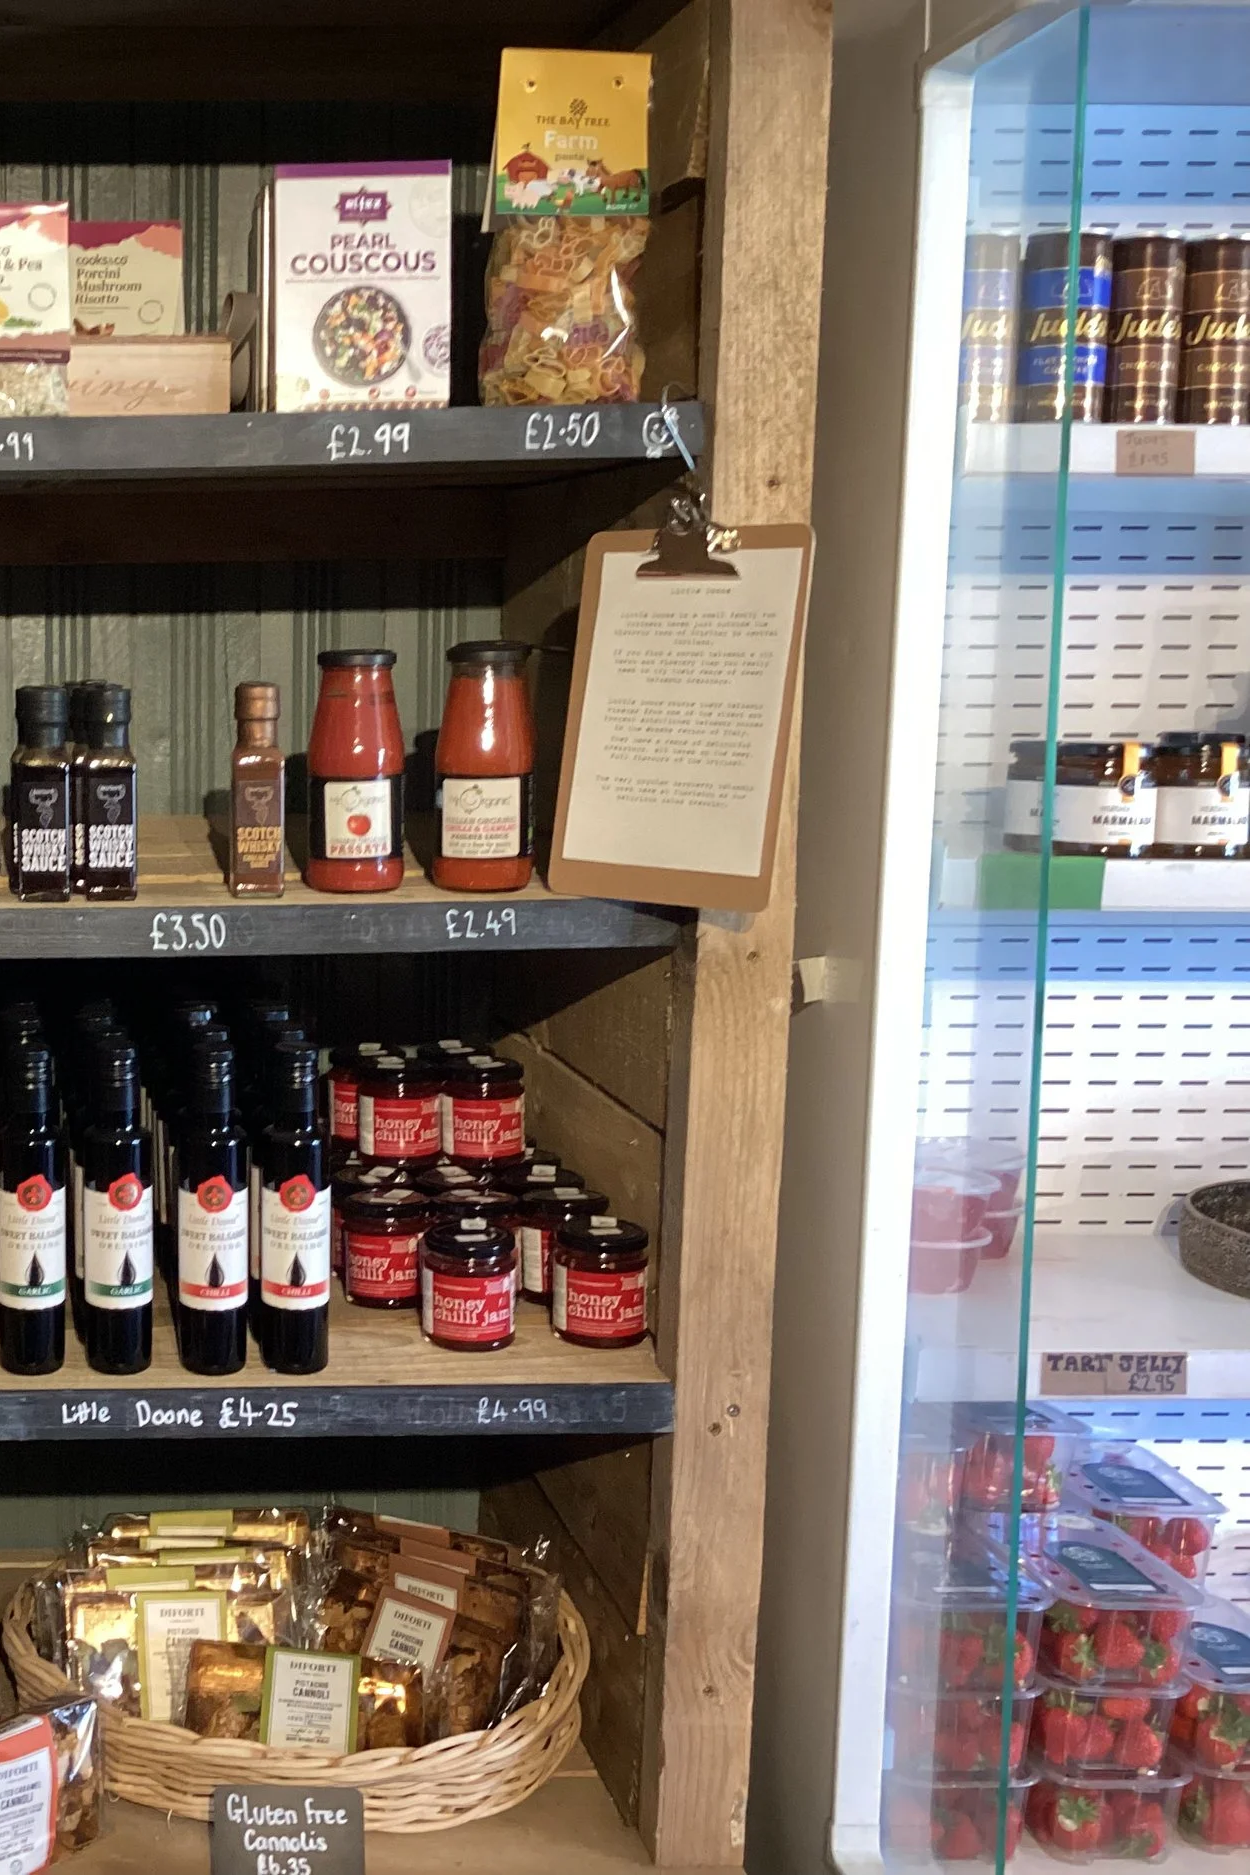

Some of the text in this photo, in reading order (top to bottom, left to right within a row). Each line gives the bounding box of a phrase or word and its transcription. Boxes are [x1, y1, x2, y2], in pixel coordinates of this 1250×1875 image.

[536, 115, 611, 128] THE BAY TREE
[544, 130, 598, 150] Farm
[330, 233, 396, 250] PEARL
[18, 258, 43, 271] Pea
[290, 251, 437, 277] COUSCOUS
[76, 268, 121, 280] Porcini
[76, 280, 142, 292] Mushroom
[75, 292, 120, 304] Risotto
[525, 411, 601, 451] £2.50
[327, 422, 411, 460] £2.99
[21, 828, 66, 843] SCOTCH
[88, 824, 133, 840] SCOTCH
[237, 826, 282, 840] SCOTCH
[21, 842, 66, 856] WHISKY
[88, 838, 133, 853] WHISKY
[237, 839, 282, 853] WHISKY
[21, 854, 66, 872] SAUCE
[88, 851, 134, 868] SAUCE
[149, 912, 227, 950] £3.50
[446, 907, 516, 939] £2.49
[374, 1115, 422, 1130] honey
[454, 1115, 501, 1130] honey
[375, 1127, 440, 1142] chilli jam
[454, 1127, 522, 1143] chilli jam
[387, 1266, 418, 1283] jam
[18, 1286, 51, 1296] GARLIC
[110, 1286, 142, 1295] GARLIC
[199, 1287, 230, 1296] CHILLI
[281, 1287, 311, 1296] CHILLI
[568, 1287, 622, 1306] honey
[433, 1291, 485, 1310] honey
[433, 1304, 511, 1326] chilli jam
[567, 1302, 645, 1323] chilli jam
[1047, 1354, 1185, 1374] TART JELLY
[61, 1398, 299, 1429] Little Doone £4.25
[476, 1397, 548, 1424] £4.99
[407, 1583, 445, 1602] DIFORTI
[160, 1608, 205, 1618] DIFORTI
[393, 1611, 433, 1630] DIFORTI
[389, 1639, 420, 1657] CANNOLI
[290, 1661, 337, 1673] DIFORTI
[295, 1680, 329, 1689] PISTACHIO
[293, 1688, 330, 1700] CANNOLI
[0, 1792, 35, 1811] CANNOLI
[226, 1793, 298, 1826] Gluten
[243, 1828, 328, 1852] Cannolis
